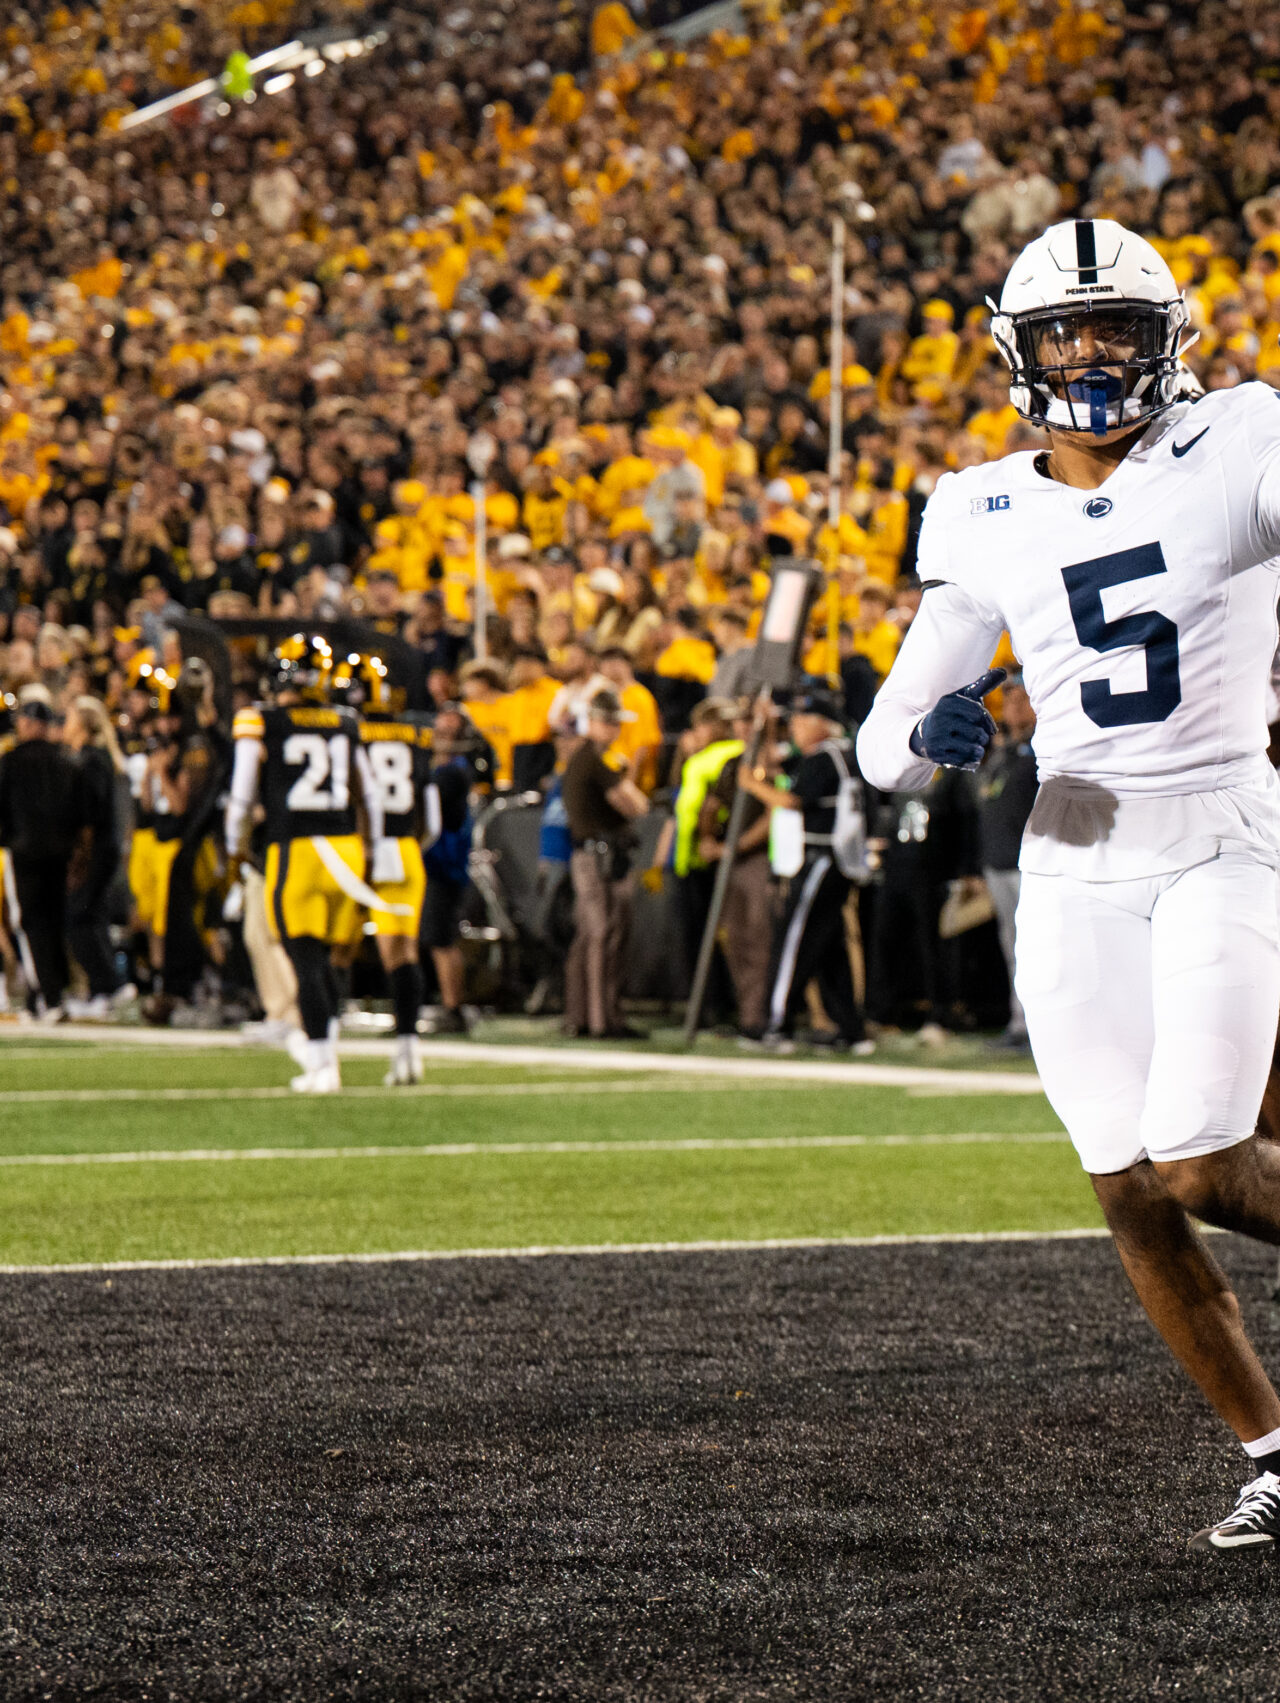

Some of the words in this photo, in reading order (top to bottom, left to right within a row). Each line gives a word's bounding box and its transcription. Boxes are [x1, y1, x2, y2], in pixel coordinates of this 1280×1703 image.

[1065, 287, 1088, 295] PENN
[1089, 285, 1114, 293] STATE
[1061, 541, 1182, 728] 5
[283, 733, 350, 812] 21
